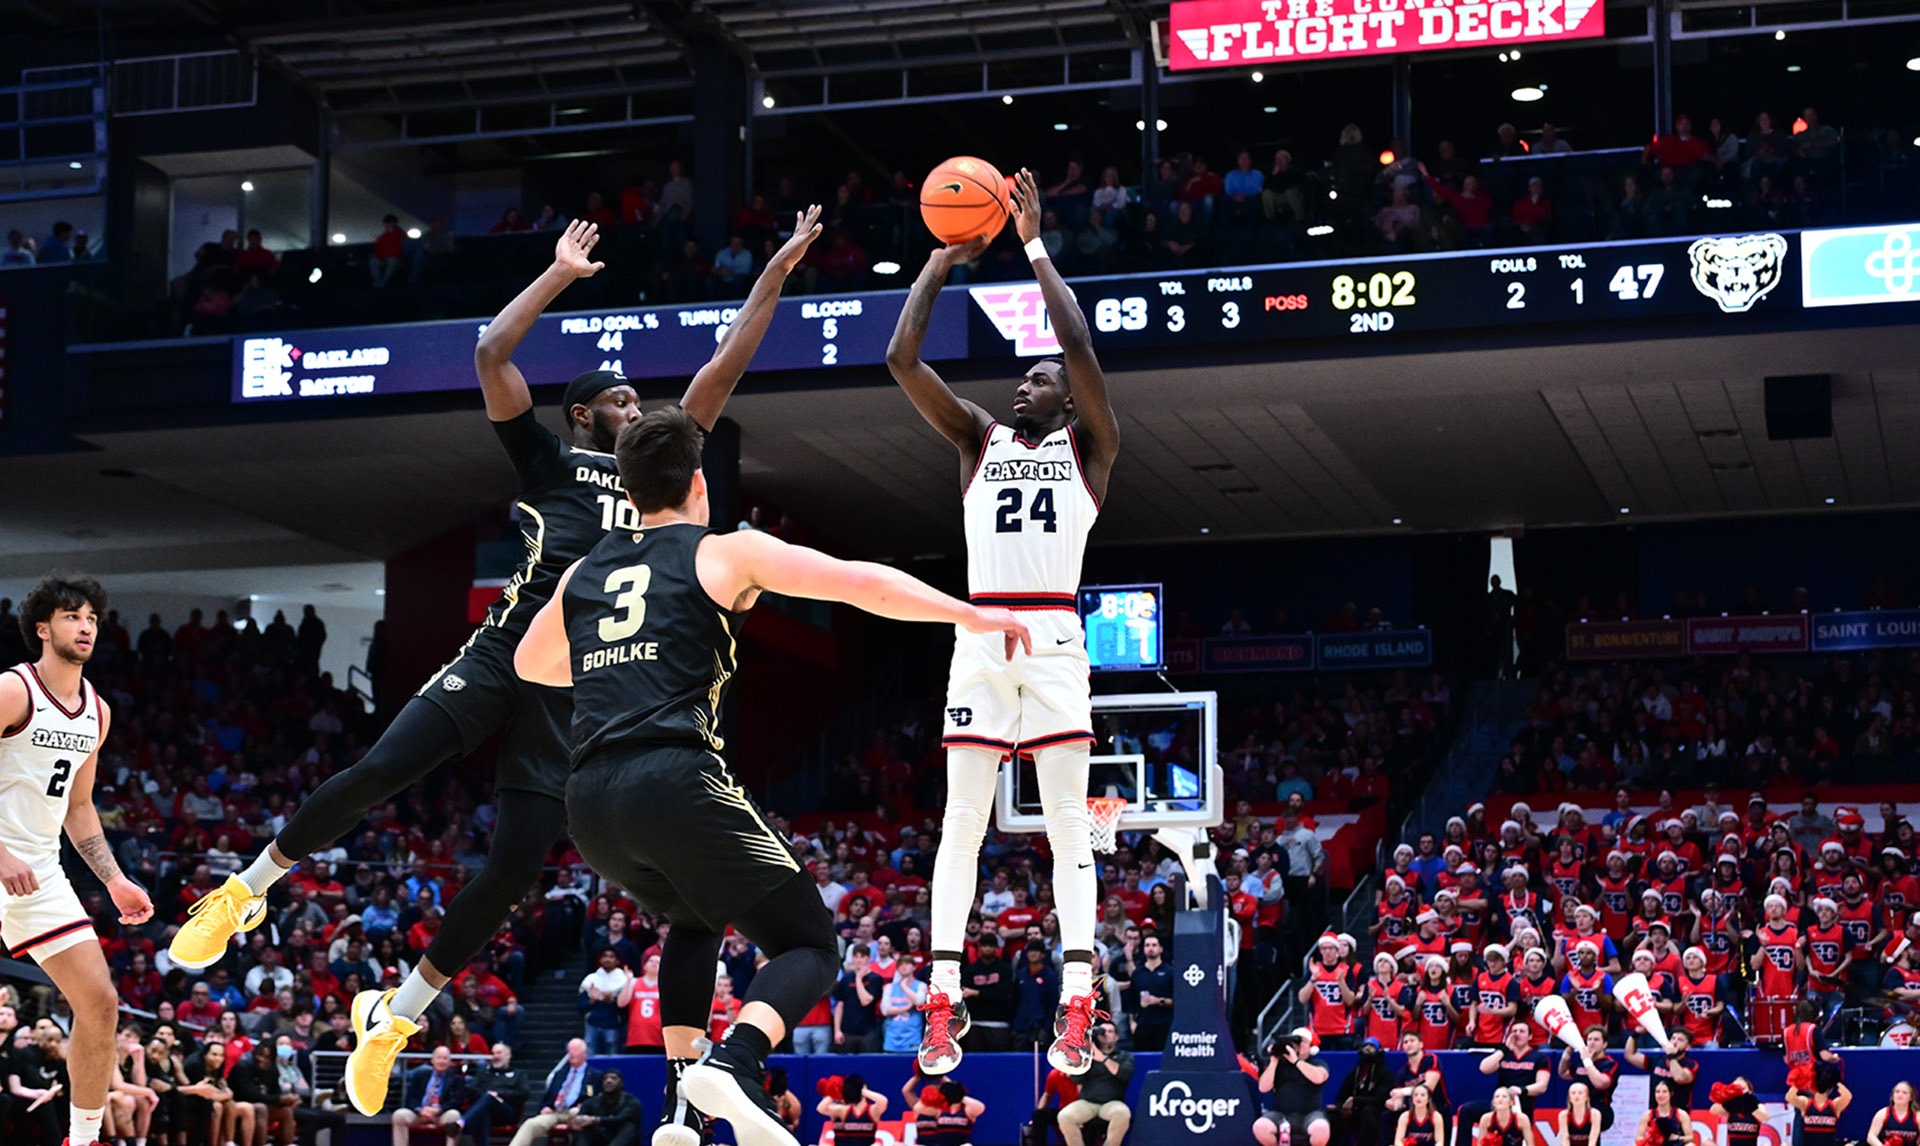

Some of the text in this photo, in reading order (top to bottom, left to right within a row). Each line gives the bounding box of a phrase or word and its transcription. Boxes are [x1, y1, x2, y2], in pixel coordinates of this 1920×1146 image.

[1261, 0, 1334, 21] THE
[1208, 0, 1563, 61] FLIGHT DECK
[1490, 257, 1537, 274] FOULS
[1558, 254, 1586, 269] TOL
[1159, 281, 1186, 295] TOL
[1207, 276, 1253, 292] FOULS
[1332, 271, 1416, 310] 8:02
[1570, 278, 1583, 304] 1
[1608, 263, 1665, 300] 47
[1265, 294, 1308, 312] POSS
[1506, 282, 1525, 309] 2
[678, 310, 720, 327] TURN
[801, 300, 863, 319] BLOCKS
[1095, 297, 1148, 332] 63
[1167, 305, 1185, 332] 3
[1221, 302, 1240, 329] 3
[561, 313, 659, 334] FIELD GOAL %
[822, 318, 837, 339] 5
[1350, 311, 1394, 333] 2ND
[597, 331, 624, 351] 44
[303, 347, 389, 369] OAKLAND
[822, 343, 837, 365] 2
[299, 375, 375, 396] DAYTON
[576, 466, 626, 492] OAKL
[984, 460, 1072, 482] DAYTON
[596, 494, 640, 531] 10
[995, 488, 1057, 533] 24
[598, 564, 651, 642] 3
[1571, 631, 1680, 648] ST. BONAVENTURE
[1817, 624, 1868, 638] SAINT
[583, 642, 659, 672] GOHLKE
[1324, 640, 1425, 659] RHODE ISLAND
[31, 728, 96, 753] DAYTON
[46, 759, 72, 798] 2
[641, 999, 654, 1018] 6
[1171, 1031, 1218, 1045] Premier
[1175, 1044, 1214, 1057] Health
[1149, 1081, 1240, 1134] Kroger
